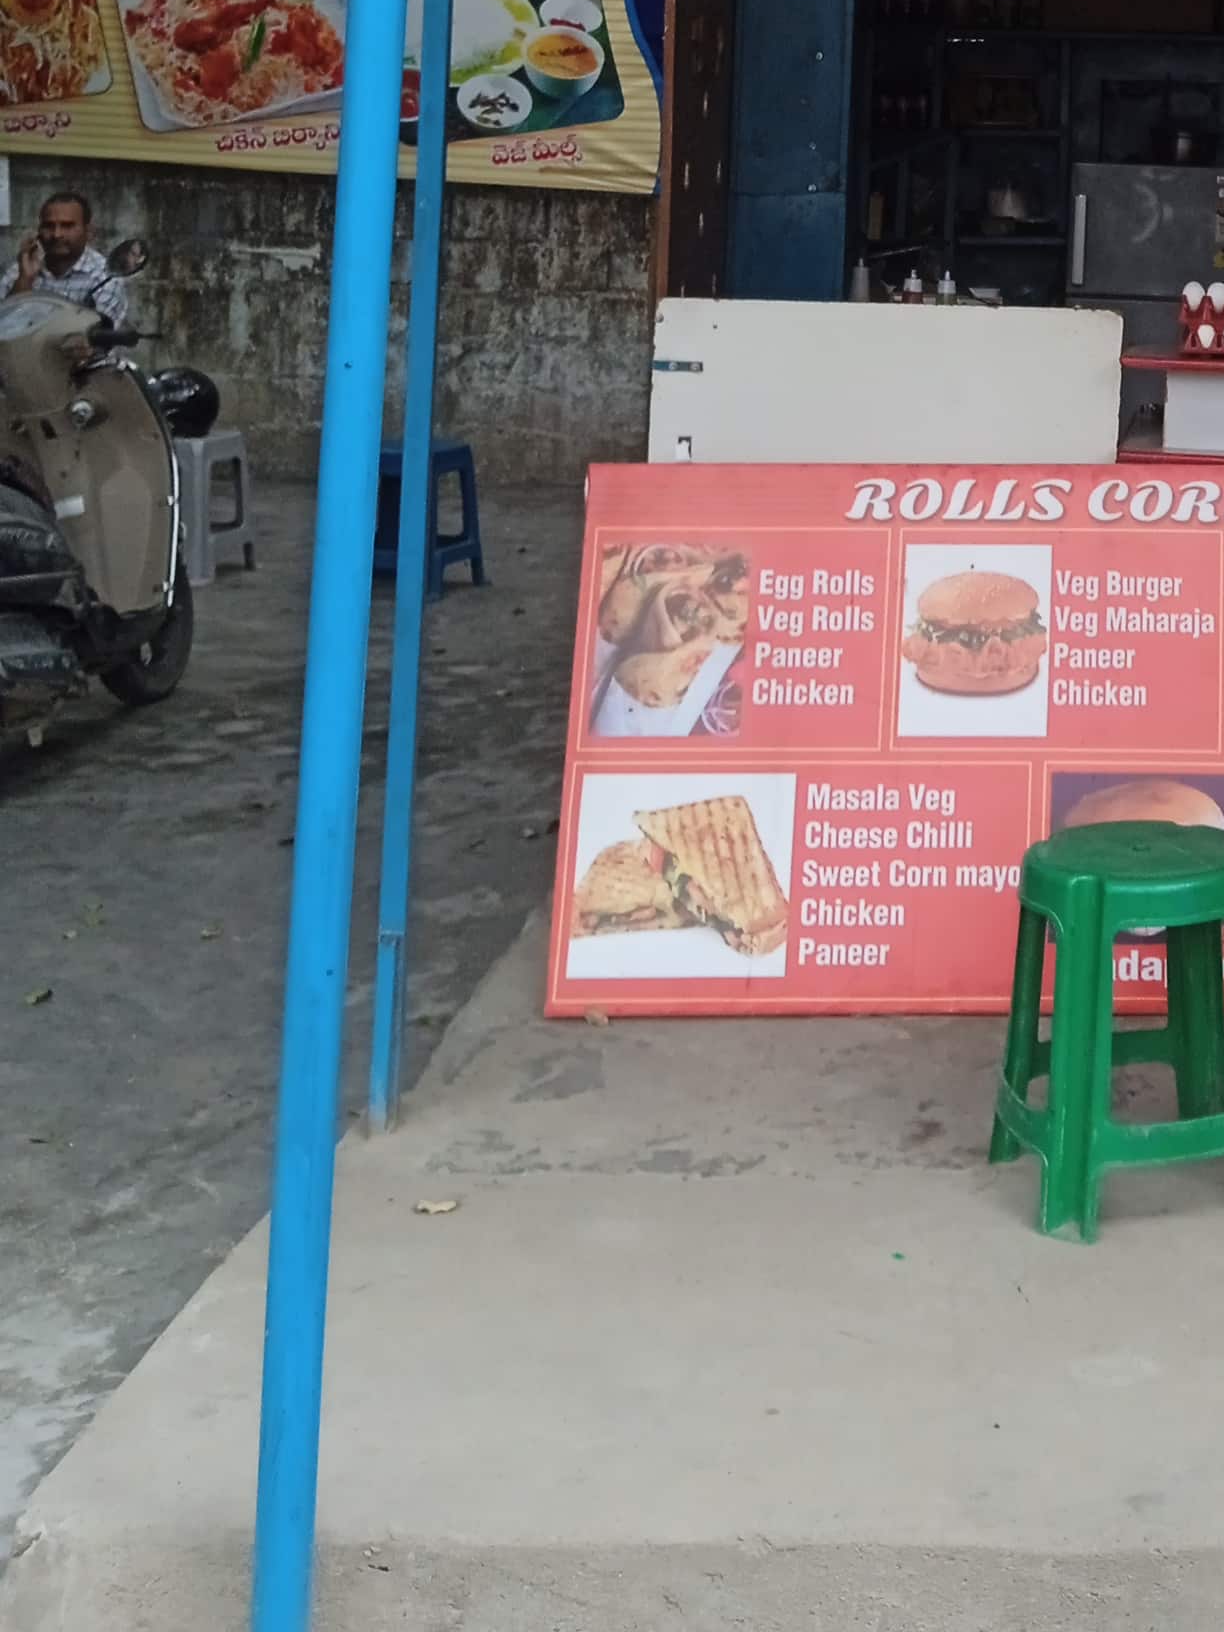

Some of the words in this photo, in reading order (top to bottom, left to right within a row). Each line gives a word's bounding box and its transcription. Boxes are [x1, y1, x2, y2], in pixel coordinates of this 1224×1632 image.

[845, 478, 1073, 522] ROLLS
[759, 568, 804, 601] Egg
[812, 568, 875, 596] Rolls
[1055, 569, 1099, 602] Veg
[1106, 569, 1183, 602] Burger
[757, 605, 804, 638] Veg
[811, 605, 875, 632] Rolls
[1054, 605, 1099, 638] Veg
[1105, 606, 1215, 639] Maharaja
[754, 641, 844, 669] Paneer
[1053, 642, 1136, 669] Paneer
[751, 677, 855, 705] Chicken
[1052, 677, 1147, 706] Chicken
[806, 783, 900, 811] Masala
[908, 783, 956, 817] Veg
[804, 820, 899, 849] Cheese
[905, 820, 973, 849] Chilli
[801, 858, 881, 887] Sweet
[888, 858, 947, 887] Corn
[954, 864, 1022, 893] mayo
[799, 897, 905, 927] Chicken
[797, 937, 891, 967] Paneer
